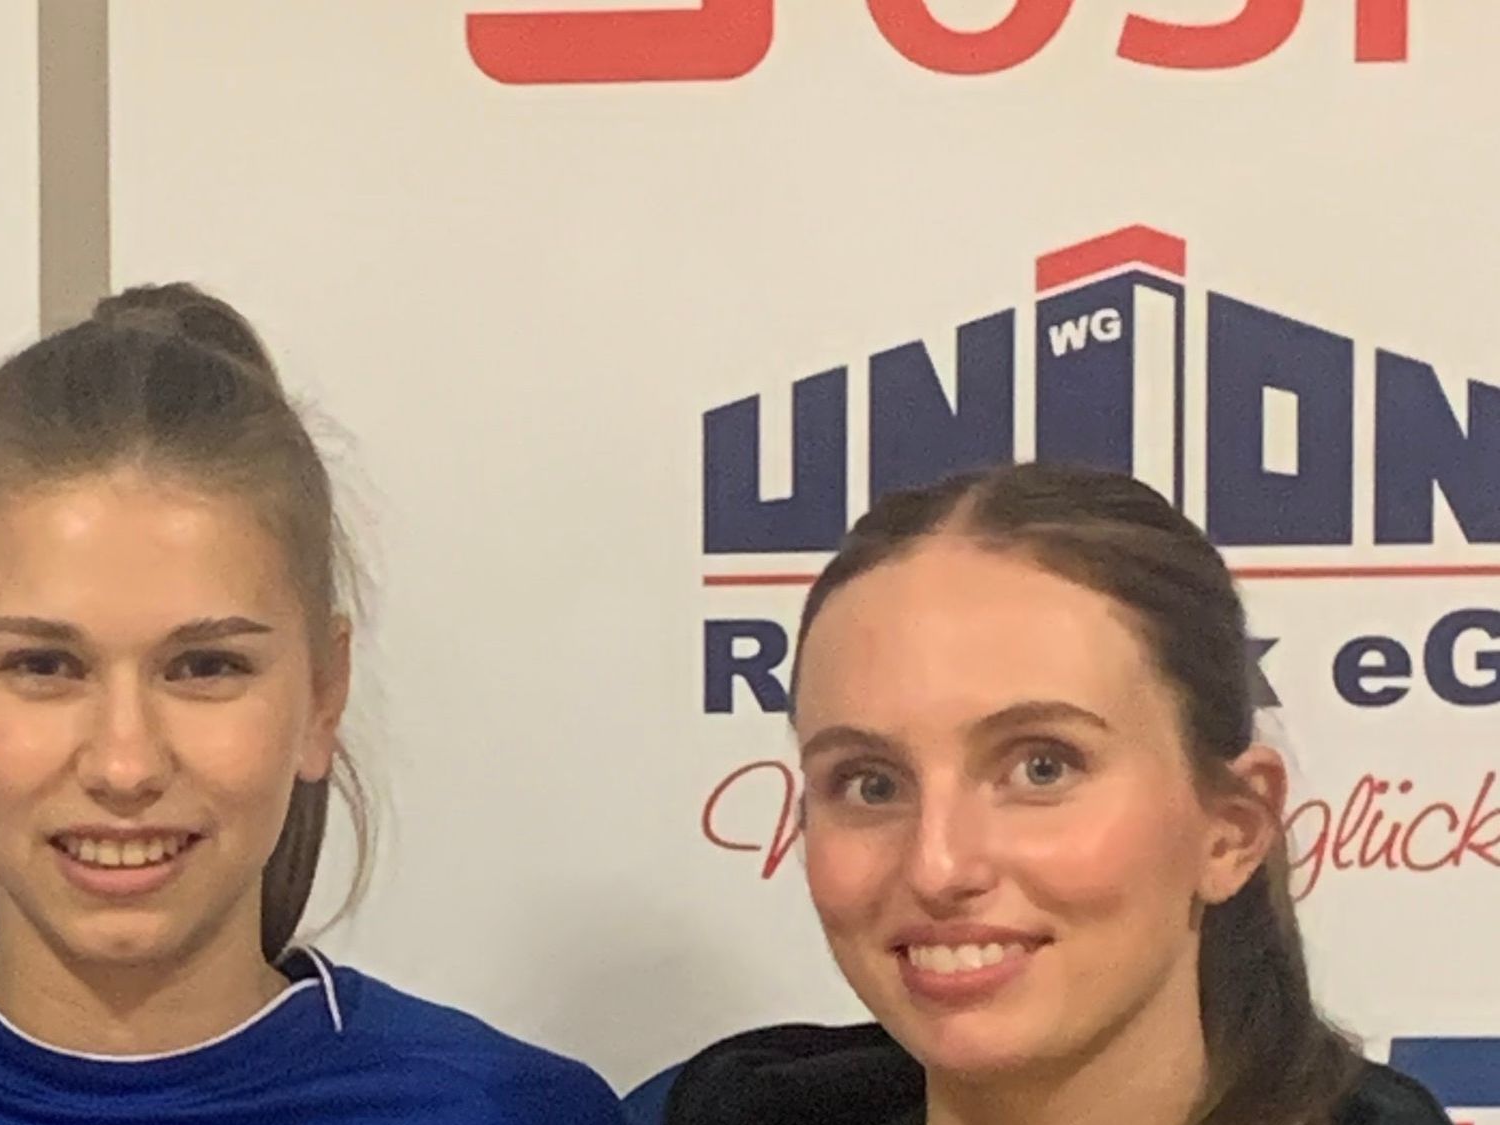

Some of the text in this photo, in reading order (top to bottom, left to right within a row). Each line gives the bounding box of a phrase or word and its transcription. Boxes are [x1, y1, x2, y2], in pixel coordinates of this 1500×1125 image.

[1049, 307, 1123, 357] WG
[703, 270, 1500, 553] UNION
[1332, 608, 1500, 707] eG
